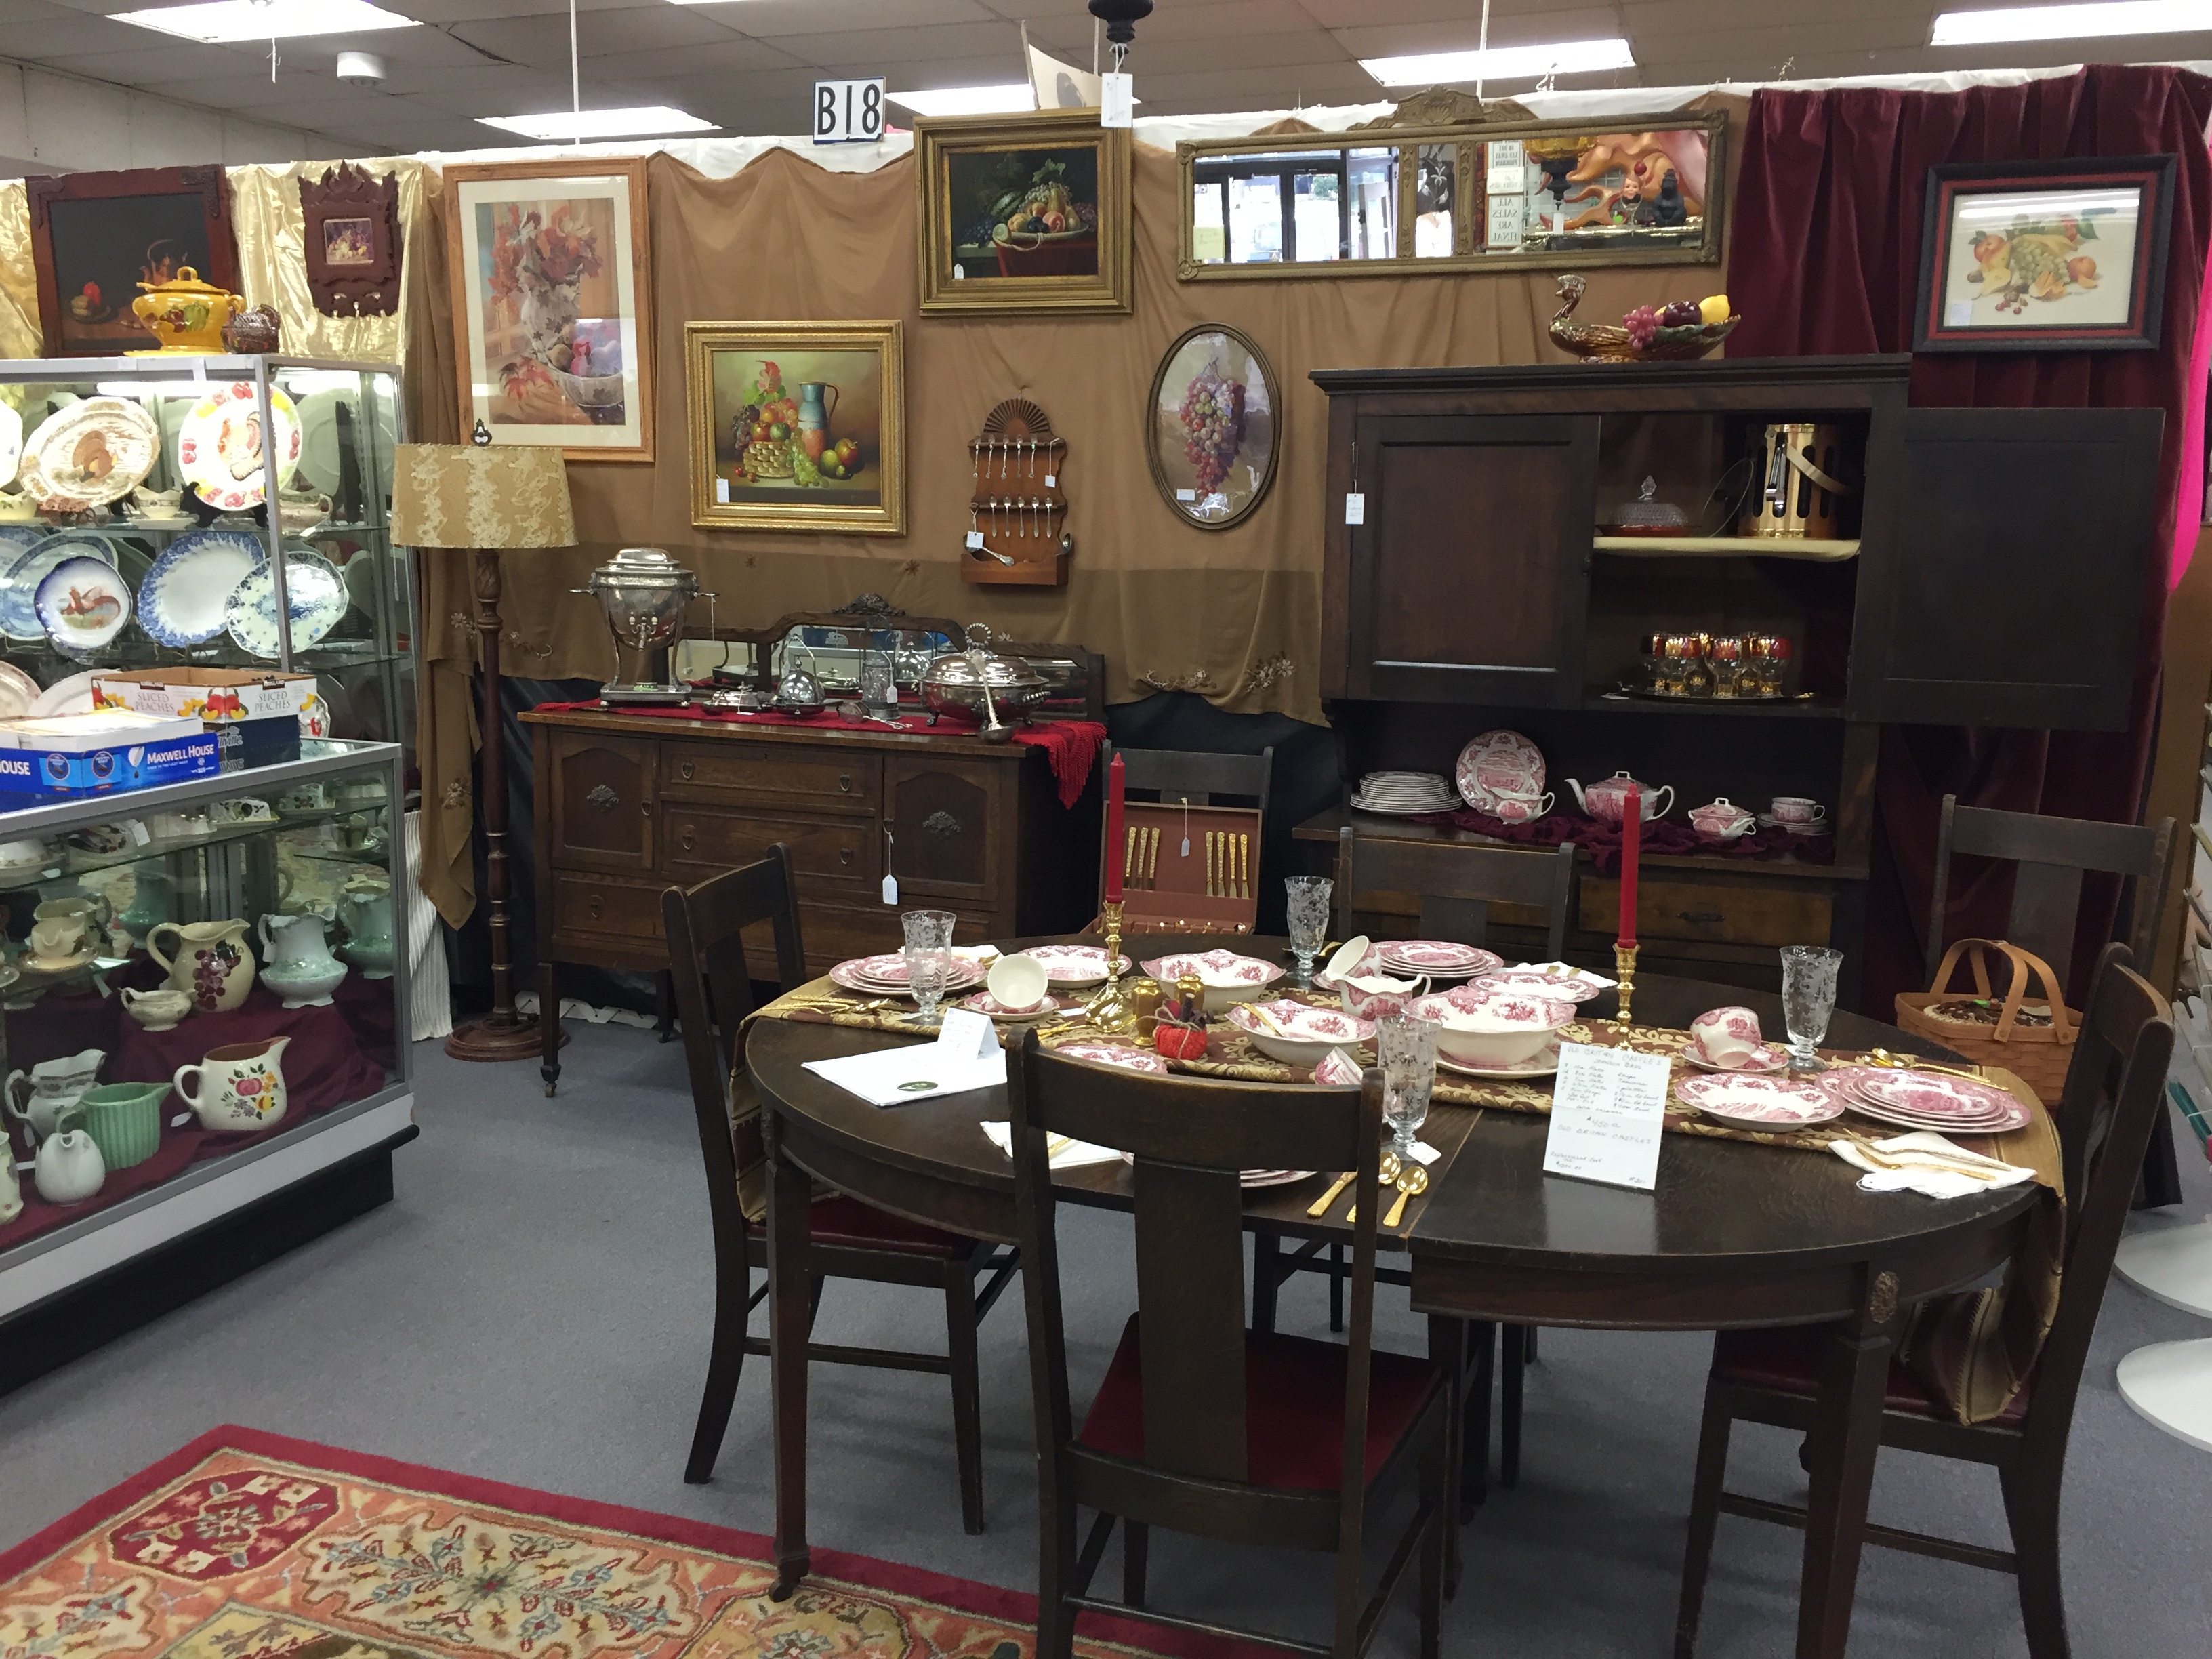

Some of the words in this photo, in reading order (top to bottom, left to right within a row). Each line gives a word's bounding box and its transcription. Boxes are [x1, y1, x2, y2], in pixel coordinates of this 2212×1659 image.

[817, 83, 880, 135] B18
[138, 692, 169, 703] SLICED
[258, 691, 288, 703] SLICED
[135, 701, 175, 712] PEACHES
[254, 699, 291, 712] PEACHES
[147, 749, 188, 764] MAXWELL
[188, 744, 215, 758] HOUSE
[0, 760, 31, 775] OUSE
